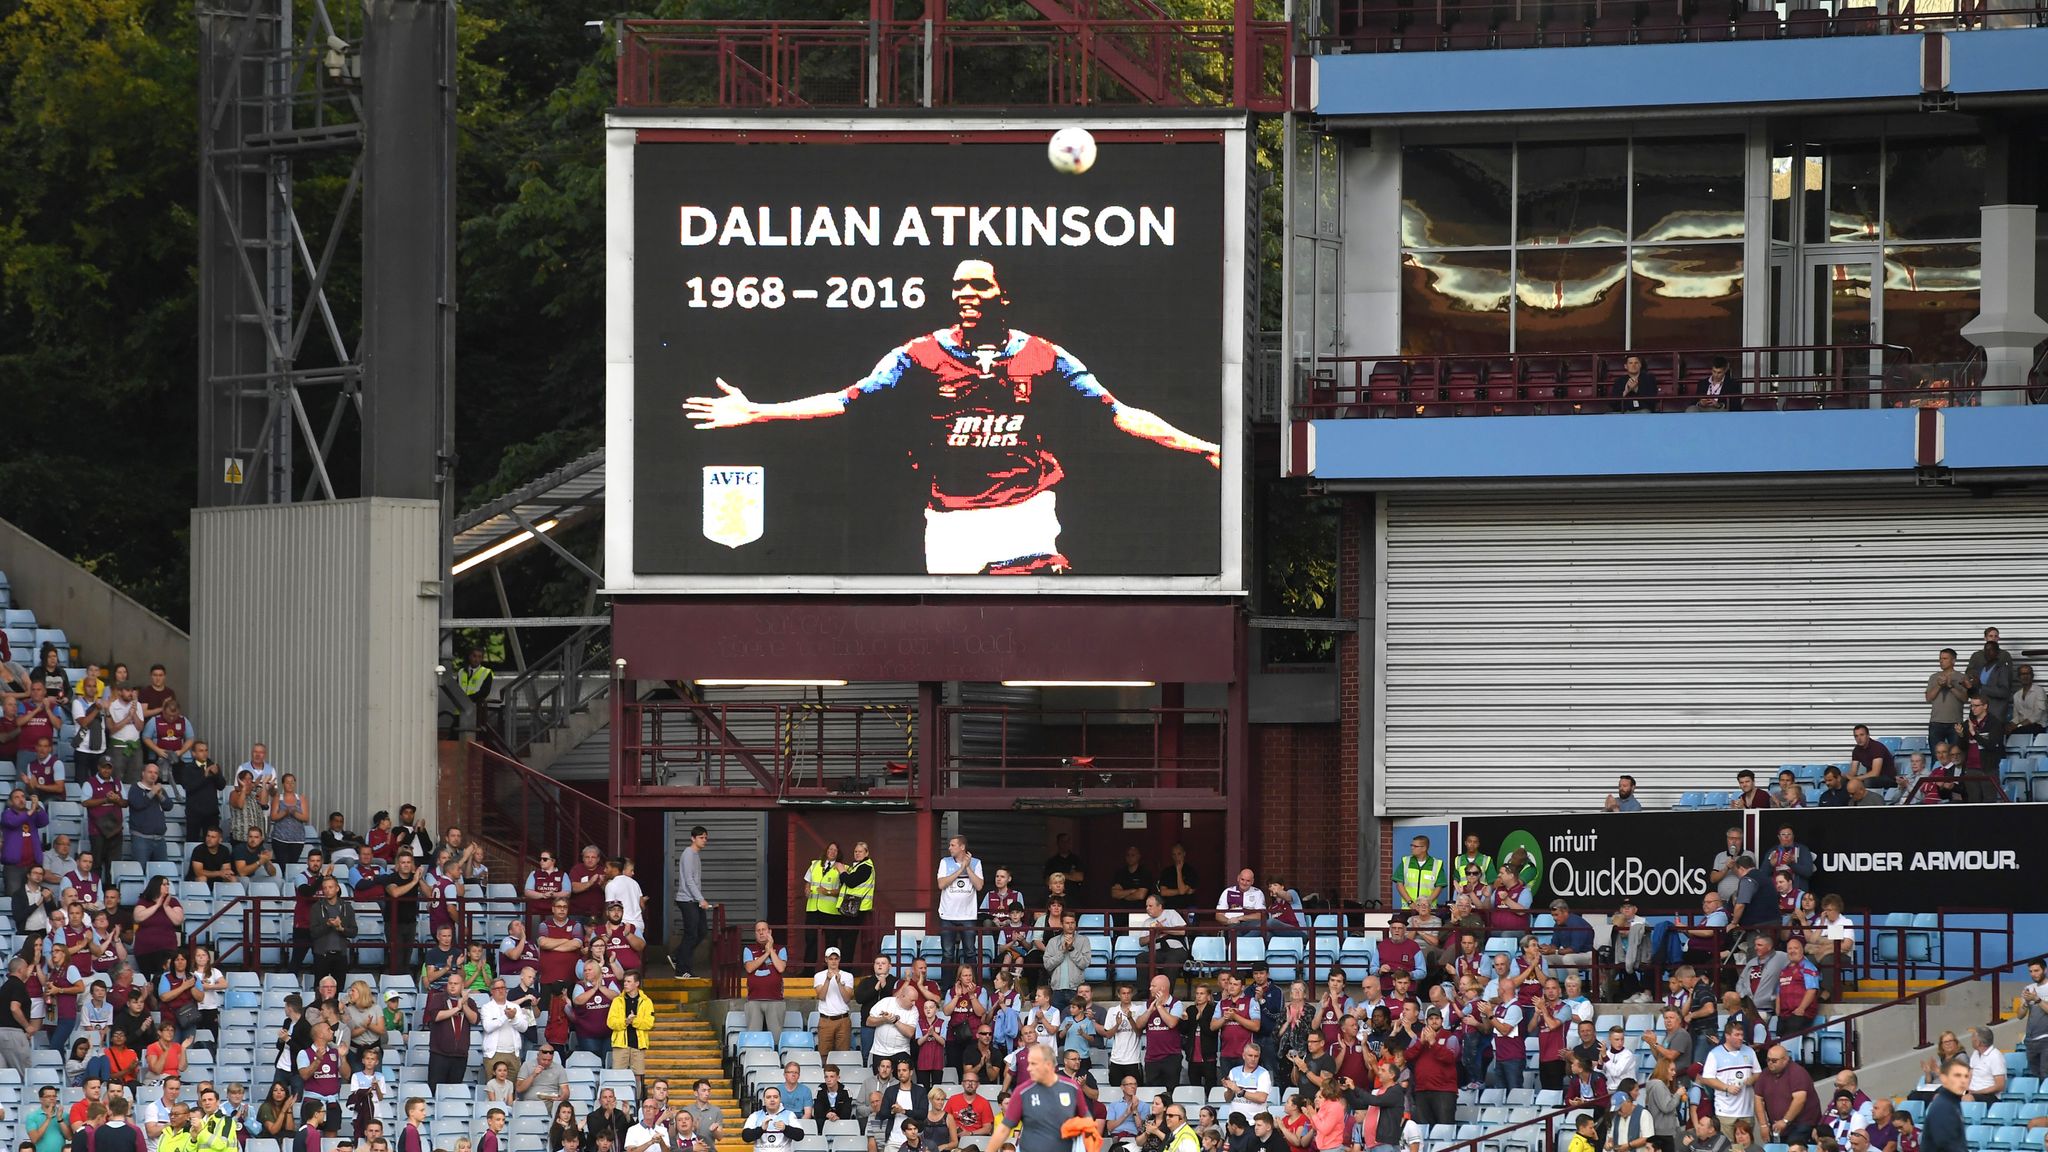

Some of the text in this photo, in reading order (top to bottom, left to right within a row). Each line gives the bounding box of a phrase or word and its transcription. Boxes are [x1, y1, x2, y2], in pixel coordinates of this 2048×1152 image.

[680, 206, 1175, 247] DALIAN ATKINSON
[686, 276, 786, 309] 1968
[826, 276, 926, 309] 2016
[952, 414, 1025, 433] mita
[709, 471, 758, 486] AVFC
[1550, 829, 1598, 852] intuit
[1823, 852, 1903, 872] UNDER
[1549, 856, 1707, 896] QuickBooks
